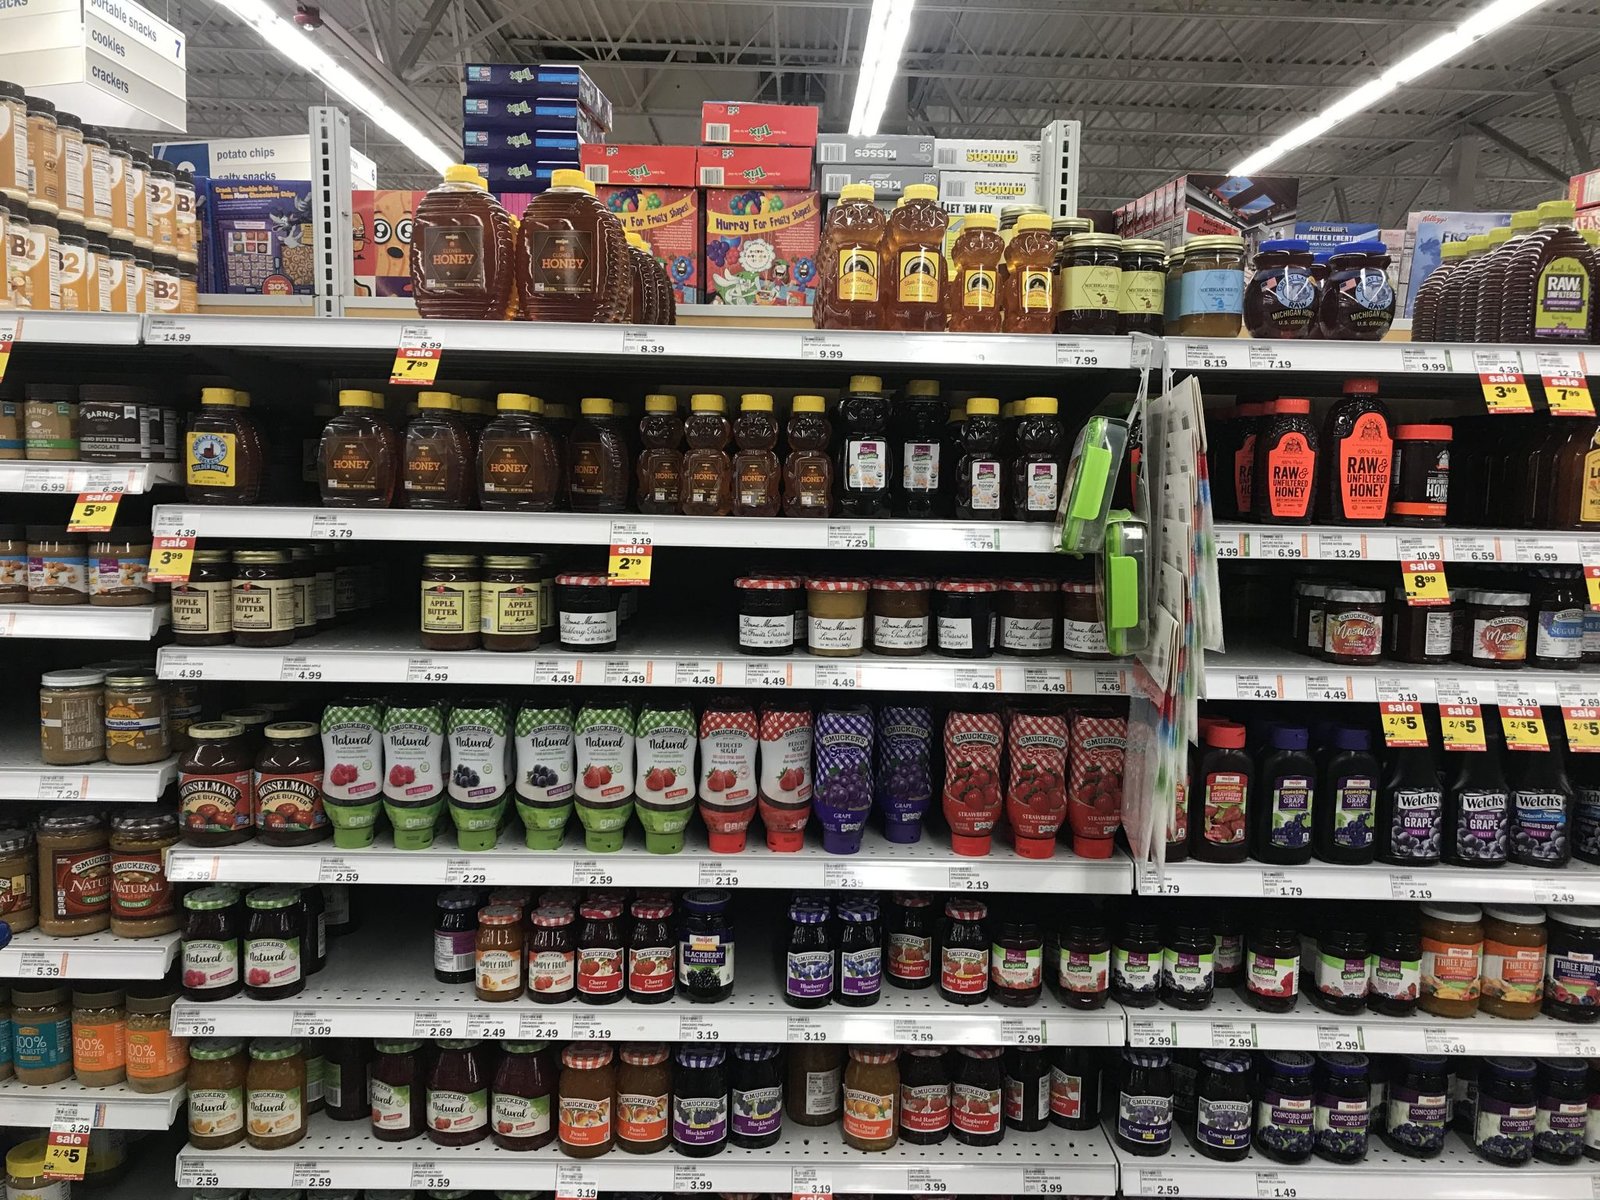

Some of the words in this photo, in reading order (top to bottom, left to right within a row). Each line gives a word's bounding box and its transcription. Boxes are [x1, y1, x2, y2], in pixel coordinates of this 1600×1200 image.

[129, 16, 157, 42] snacks
[92, 28, 126, 57] cookies
[174, 40, 181, 58] 7
[92, 65, 129, 94] crackers
[217, 150, 247, 161] potato
[250, 148, 275, 159] chips
[242, 171, 276, 180] snacks
[946, 204, 961, 214] LET
[979, 204, 993, 214] FLY
[631, 216, 645, 228] For
[647, 212, 668, 225] Fruity
[716, 218, 749, 231] Hurray
[753, 216, 768, 228] For
[770, 214, 791, 227] Fruity
[1309, 225, 1349, 234] MINECRAFT
[432, 254, 473, 265] HONEY
[541, 258, 584, 270] HONEY
[153, 280, 179, 300] B2
[1547, 291, 1581, 299] UNFILTERED
[1272, 309, 1301, 321] MICHIGAN
[1350, 310, 1379, 321] MICHIGAN
[163, 333, 191, 342] 14.99
[406, 348, 433, 358] sale
[640, 345, 665, 353] 8.39
[819, 350, 843, 359] 9.99
[1074, 356, 1098, 365] 7.99
[1203, 360, 1228, 368] 8.19
[1267, 360, 1292, 368] 7.19
[1421, 363, 1446, 372] 9.99
[1488, 374, 1516, 384] sale
[86, 411, 121, 420] BARNEY
[333, 460, 370, 469] HONEY
[408, 462, 441, 470] HONEY
[490, 464, 527, 473] HONEY
[1347, 457, 1379, 473] RAW
[693, 472, 718, 481] HONEY
[1273, 466, 1299, 479] RAW
[801, 475, 825, 484] HONEY
[1347, 474, 1388, 484] UNFILTERED
[41, 483, 65, 492] 6.99
[1350, 484, 1385, 498] HONEY
[328, 529, 353, 537] 3.79
[845, 539, 868, 548] 7.29
[617, 545, 645, 555] sale
[1277, 548, 1301, 558] 6.99
[1334, 549, 1361, 559] 13.29
[1471, 551, 1495, 561] 6.59
[1408, 560, 1436, 572] sale
[237, 597, 262, 605] APPLE
[174, 606, 202, 615] BUTTER
[236, 605, 265, 613] BUTTER
[1334, 624, 1376, 637] Mosaics
[1551, 627, 1573, 635] SUGAR
[179, 669, 203, 678] 4.99
[298, 671, 322, 680] 4.99
[424, 672, 448, 682] 4.99
[692, 675, 716, 685] 4.49
[832, 677, 856, 687] 4.49
[1042, 682, 1066, 692] 4.49
[1254, 688, 1278, 698] 4.49
[1388, 701, 1414, 713] sale
[1389, 715, 1418, 730] 2/$5
[885, 725, 927, 737] SMUCKER'S
[331, 733, 374, 747] Natural
[389, 735, 431, 748] Natural
[455, 736, 496, 749] Natural
[531, 736, 572, 749] Natural
[584, 736, 627, 749] Natural
[824, 735, 867, 746] SMUCKER'S
[955, 733, 998, 743] SMUCKER'S
[1021, 736, 1064, 747] SMUCKER'S
[649, 738, 689, 751] Natural
[258, 779, 317, 799] MUSSELMAN'S
[56, 790, 80, 800] 7.29
[1401, 794, 1438, 807] Welch's
[1466, 795, 1504, 809] Welch's
[1519, 794, 1561, 808] Welch's
[1469, 819, 1499, 830] GRAPE
[112, 861, 158, 873] SMUCKER'S
[335, 872, 359, 882] 2.59
[463, 873, 486, 883] 2.29
[589, 875, 613, 885] 2.59
[715, 876, 739, 886] 2.19
[112, 881, 163, 894] NATURAL
[966, 880, 989, 890] 2.19
[1157, 884, 1180, 894] 1.79
[1280, 886, 1303, 896] 1.79
[1409, 889, 1432, 899] 2.19
[185, 951, 223, 964] Natural
[250, 951, 287, 963] Natural
[685, 950, 724, 960] BLACKBERRY
[498, 959, 514, 968] FRUIT
[1437, 957, 1457, 967] THREE
[1506, 960, 1526, 969] THREE
[36, 967, 60, 977] 5.39
[191, 1025, 215, 1035] 3.09
[308, 1025, 331, 1036] 3.09
[429, 1028, 453, 1037] 2.69
[482, 1028, 506, 1038] 2.49
[588, 1029, 612, 1039] 3.19
[696, 1030, 719, 1040] 3.19
[803, 1031, 827, 1041] 3.19
[911, 1032, 934, 1042] 3.59
[1018, 1034, 1041, 1044] 2.99
[1148, 1036, 1171, 1046] 2.99
[15, 1035, 47, 1049] 100%
[74, 1038, 104, 1051] 100%
[1228, 1038, 1252, 1048] 2.99
[1335, 1040, 1359, 1050] 2.99
[126, 1042, 156, 1058] 100%
[1443, 1043, 1466, 1054] 3.49
[191, 1100, 228, 1113] Natural
[250, 1100, 287, 1113] Natural
[432, 1101, 466, 1114] Natural
[922, 1115, 948, 1124] Raspberry
[1273, 1111, 1300, 1119] CONCORD
[1552, 1116, 1579, 1124] CONCORD
[747, 1119, 776, 1127] Blackberry
[965, 1115, 990, 1127] Raspberry
[685, 1129, 715, 1137] Blackberry
[1128, 1124, 1151, 1134] Concord
[1207, 1130, 1232, 1140] Concord
[53, 1148, 80, 1163] 2/$5
[308, 1177, 332, 1187] 2.59
[427, 1178, 450, 1188] 3.59
[690, 1180, 713, 1190] 3.99
[924, 1182, 947, 1192] 3.99
[1040, 1183, 1063, 1193] 3.99
[1274, 1188, 1297, 1198] 1.49
